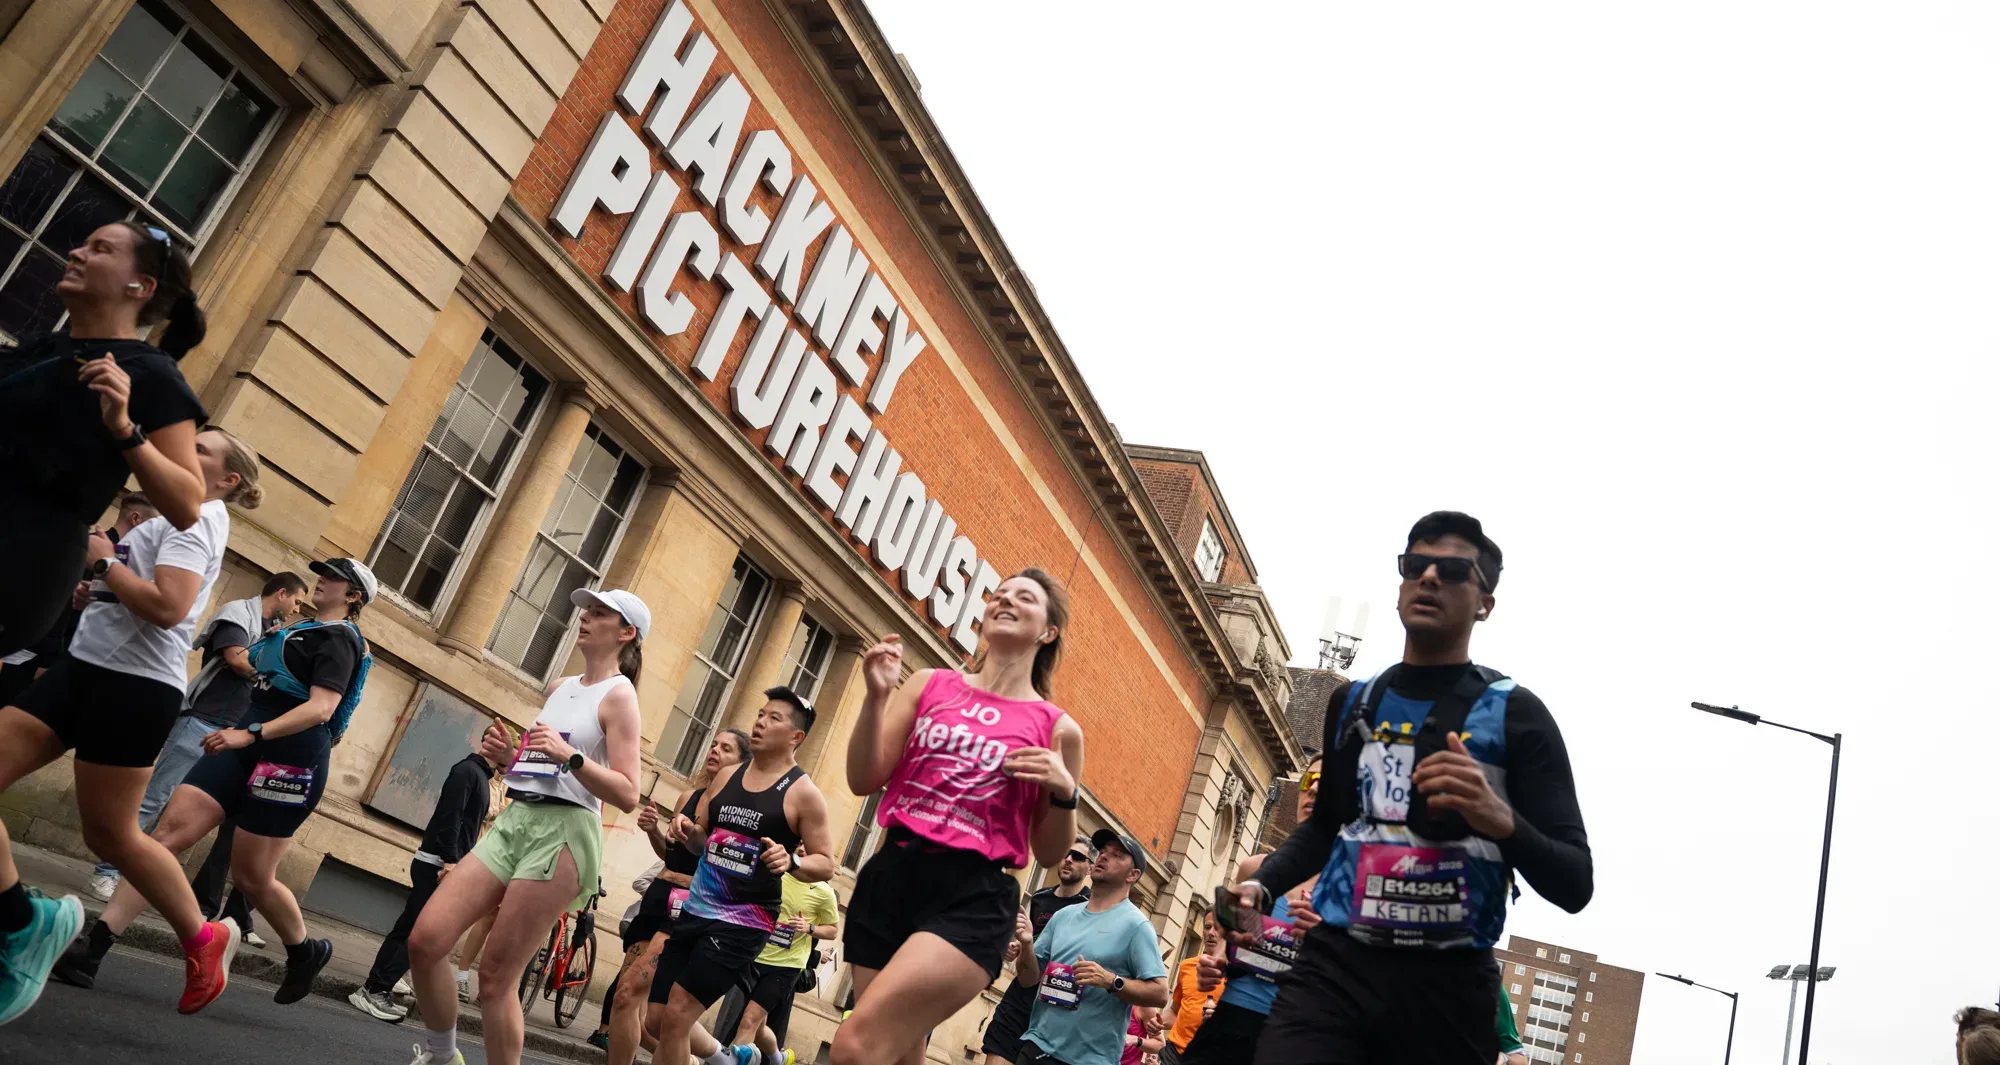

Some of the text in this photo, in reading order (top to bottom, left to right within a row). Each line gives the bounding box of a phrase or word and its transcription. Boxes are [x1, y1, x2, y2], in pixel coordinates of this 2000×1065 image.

[615, 0, 927, 415] HACKNEY
[549, 111, 1002, 657] PICTUREHOUSE
[960, 703, 1001, 726] JO
[911, 715, 1013, 776] Refug
[1383, 754, 1403, 777] St
[268, 779, 302, 791] C3149
[776, 776, 791, 791] soar
[718, 813, 759, 831] RUNNERS
[720, 805, 763, 821] MIDNIGHT
[722, 846, 745, 859] C651
[1384, 878, 1456, 896] E14264
[1375, 901, 1450, 922] KETAN
